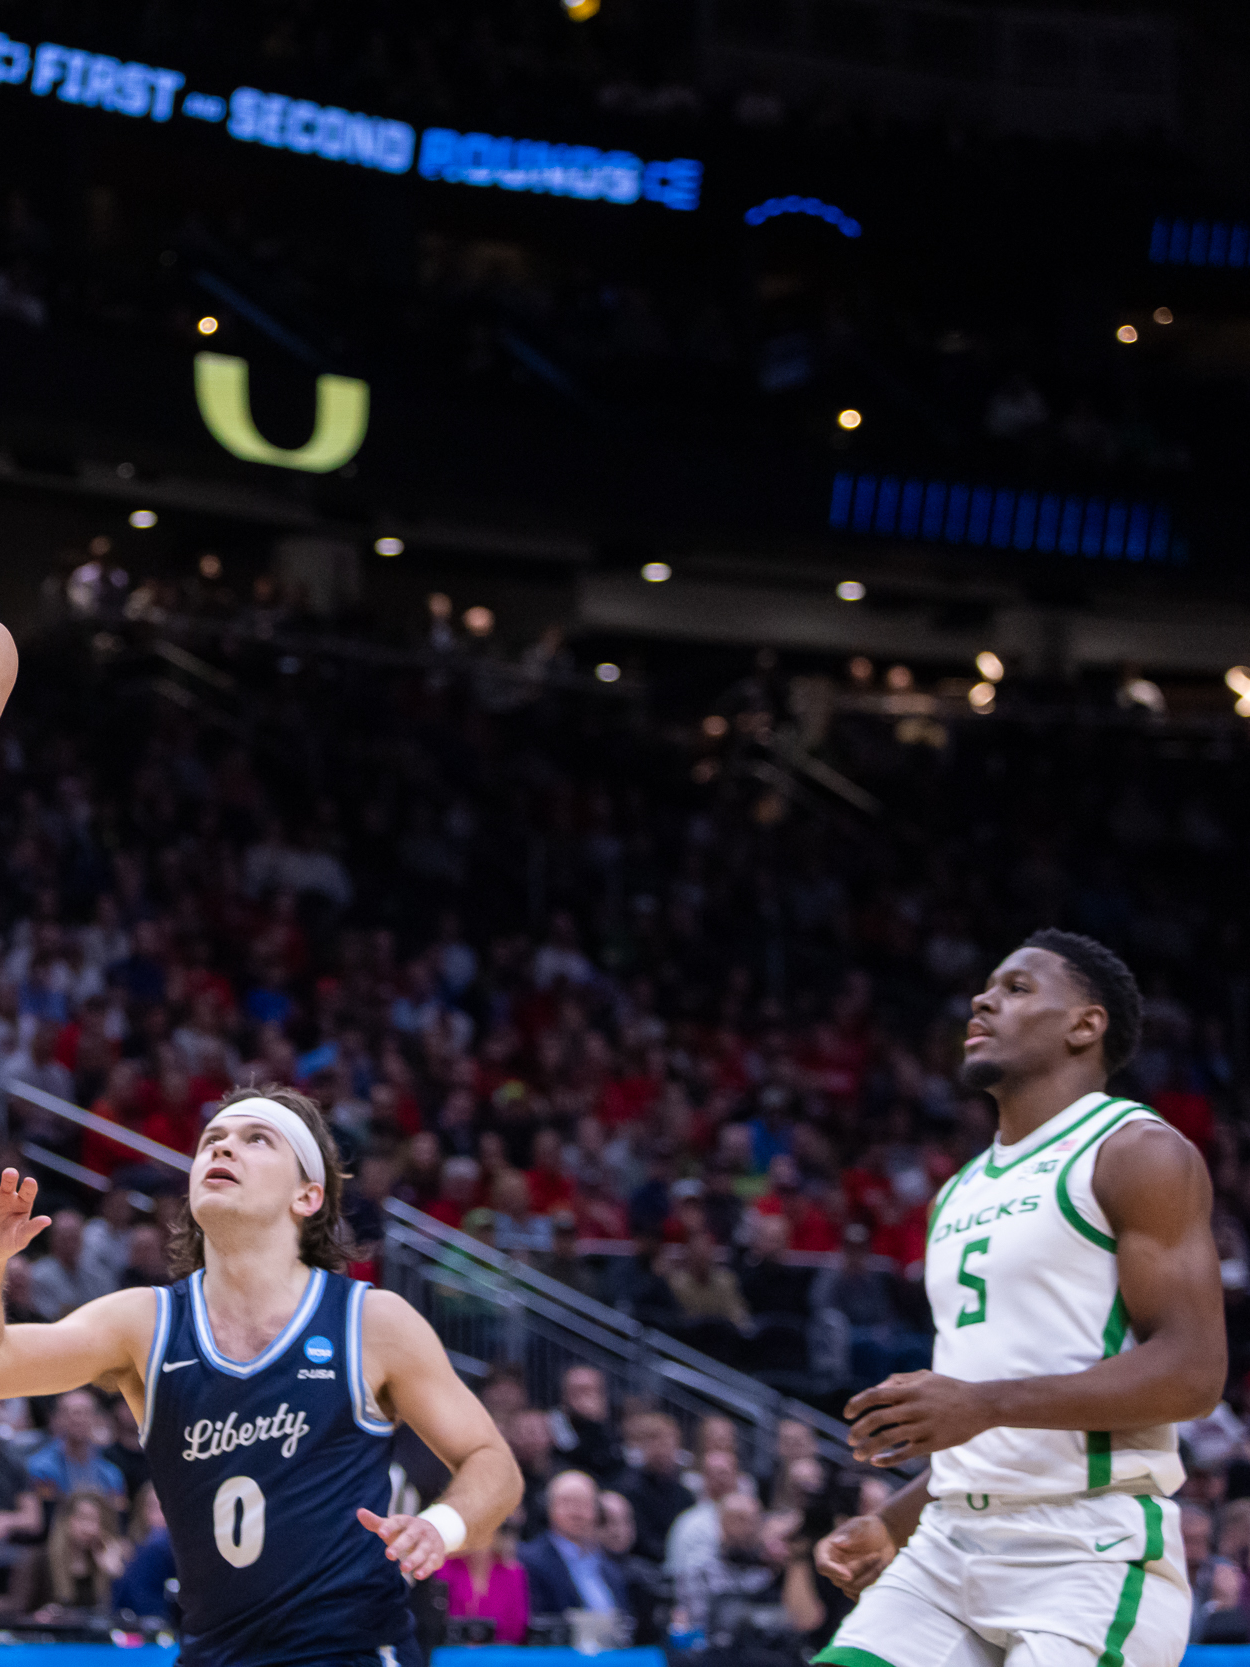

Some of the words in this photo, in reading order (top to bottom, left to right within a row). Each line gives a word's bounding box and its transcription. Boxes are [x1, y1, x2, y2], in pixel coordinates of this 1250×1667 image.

[31, 42, 185, 123] FIRST
[226, 86, 416, 175] SECOND
[934, 1195, 1041, 1243] DUCKS
[956, 1236, 991, 1329] 5
[182, 1402, 310, 1461] Liberty
[213, 1475, 267, 1568] 0
